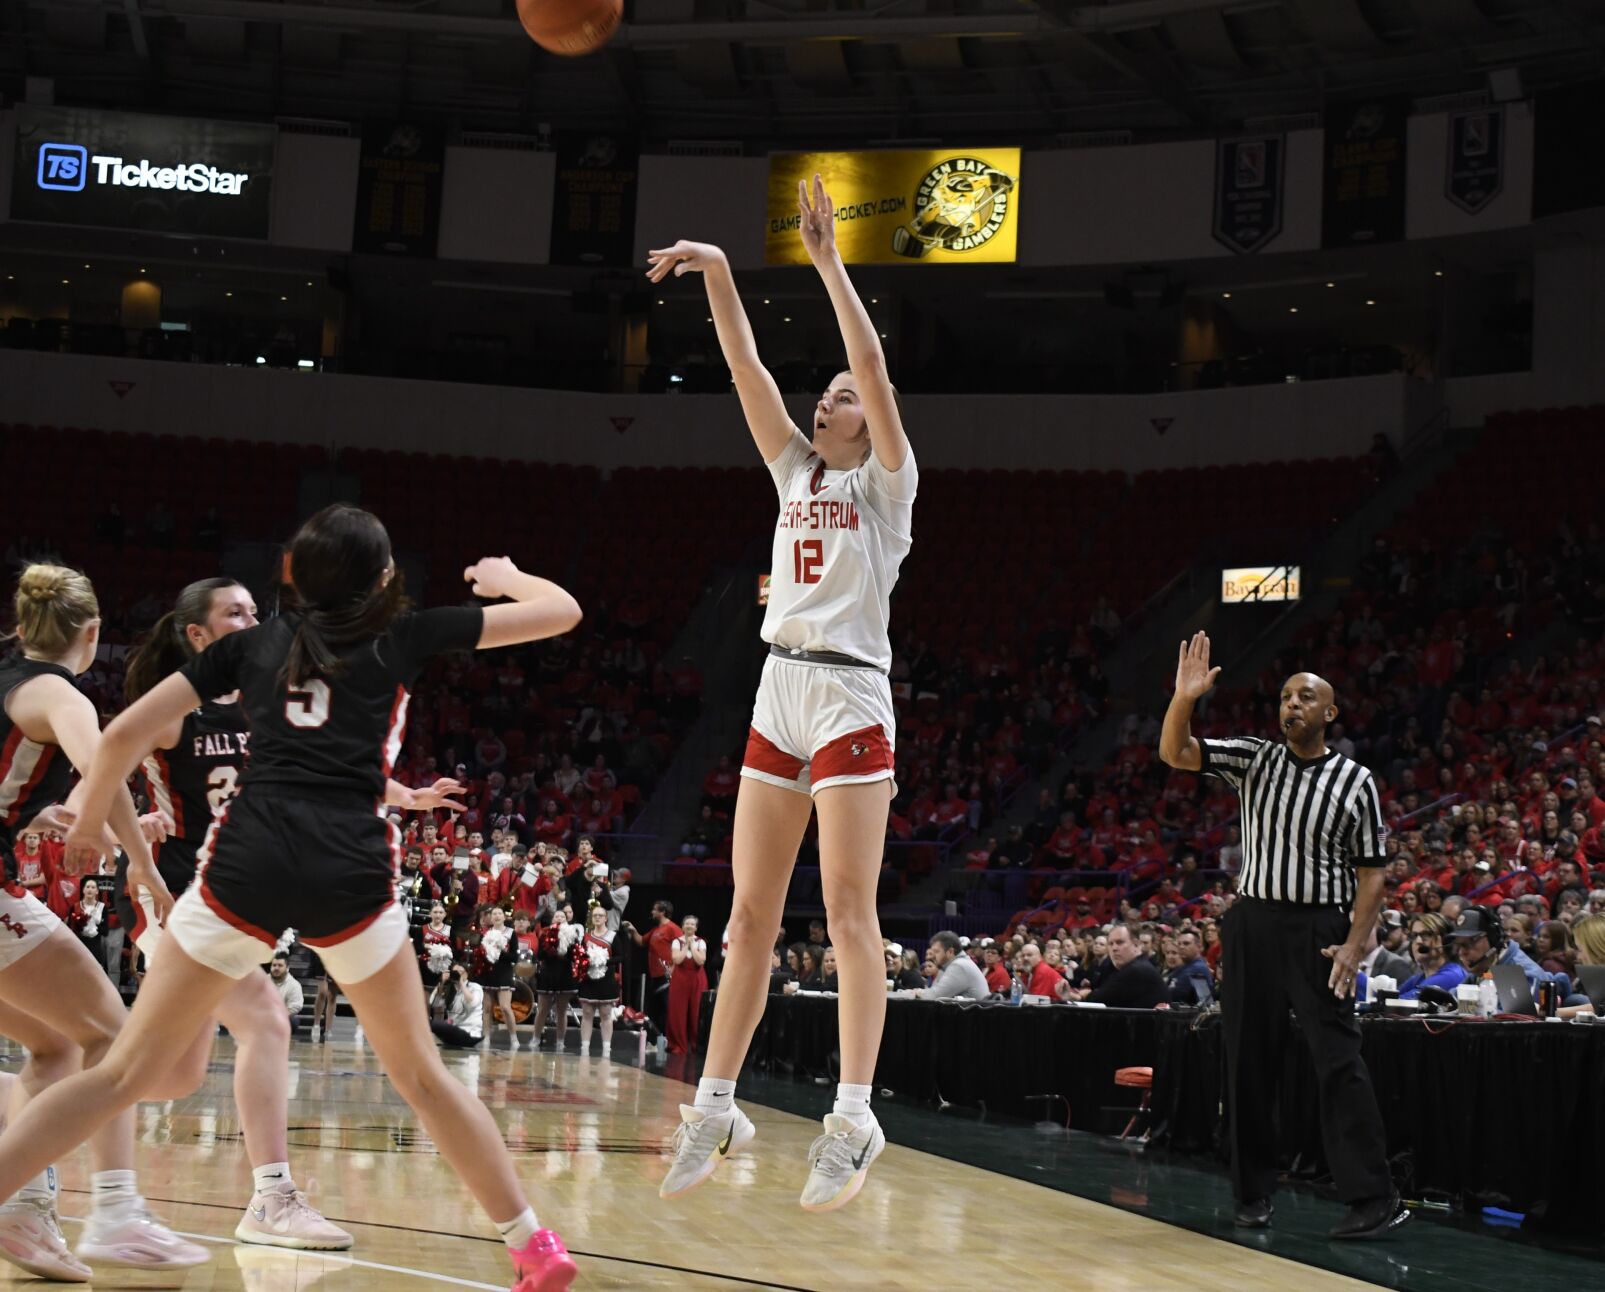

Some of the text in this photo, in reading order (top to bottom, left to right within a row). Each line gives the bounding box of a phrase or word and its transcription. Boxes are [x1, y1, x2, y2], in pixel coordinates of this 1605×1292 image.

[47, 154, 80, 179] TS
[91, 155, 249, 195] TicketStar
[917, 159, 986, 206] GREEN BAY
[952, 193, 1007, 250] GAMBLERS
[793, 538, 824, 584] 12
[193, 733, 236, 757] FALL
